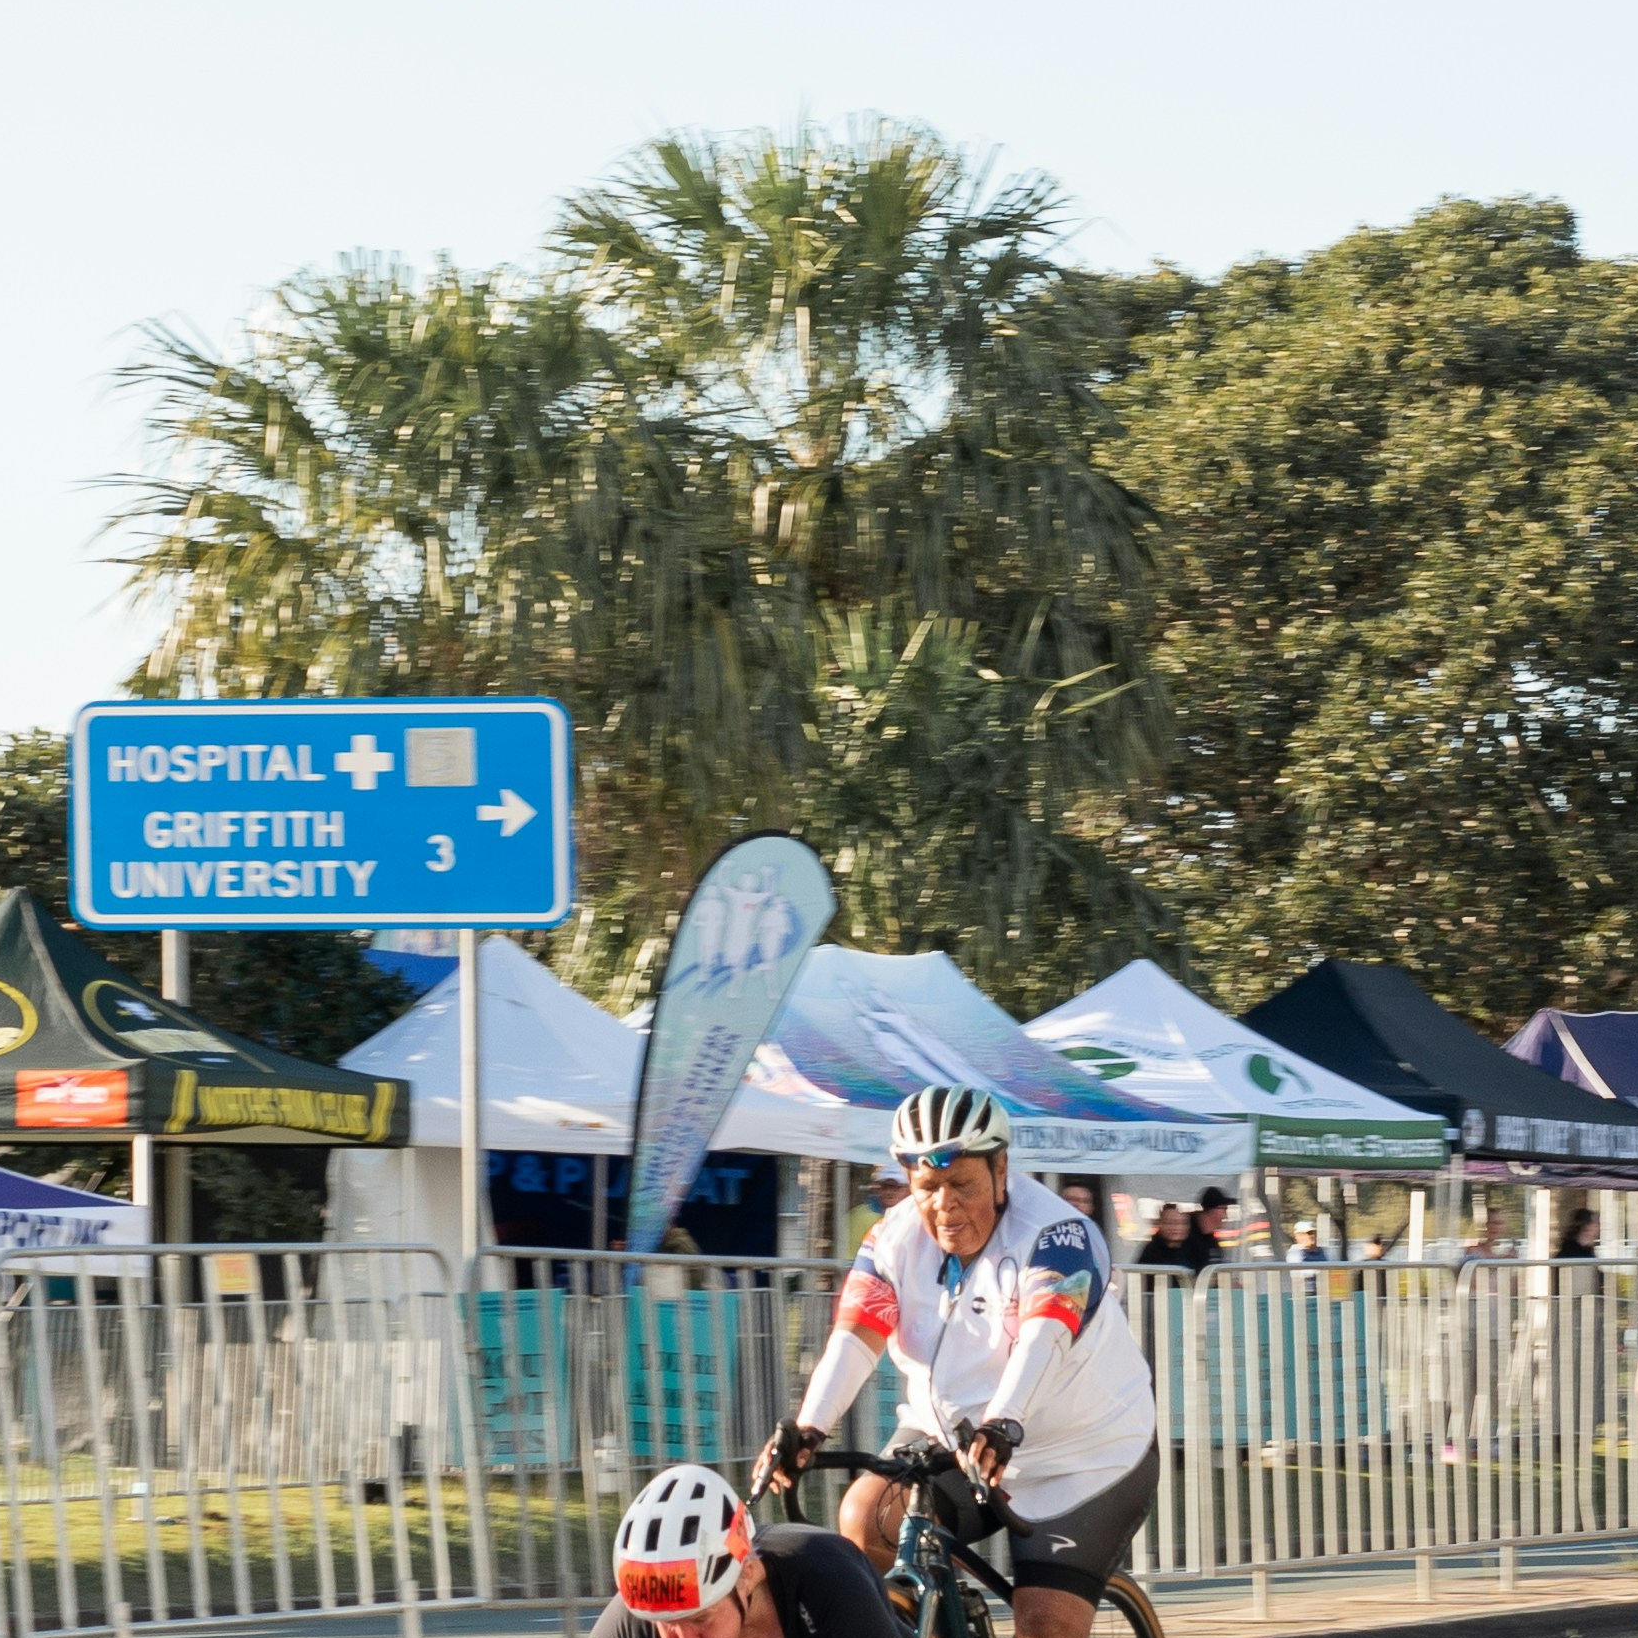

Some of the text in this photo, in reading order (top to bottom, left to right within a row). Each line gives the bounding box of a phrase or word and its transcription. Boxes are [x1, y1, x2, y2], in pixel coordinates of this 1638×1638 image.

[107, 744, 327, 782] HOSPITAL
[143, 811, 345, 849] GRIFFITH
[425, 834, 456, 873] 3
[110, 860, 378, 898] UNIVERSITY
[1260, 1129, 1320, 1155] SOUTH
[625, 1572, 686, 1604] SHARNIE
